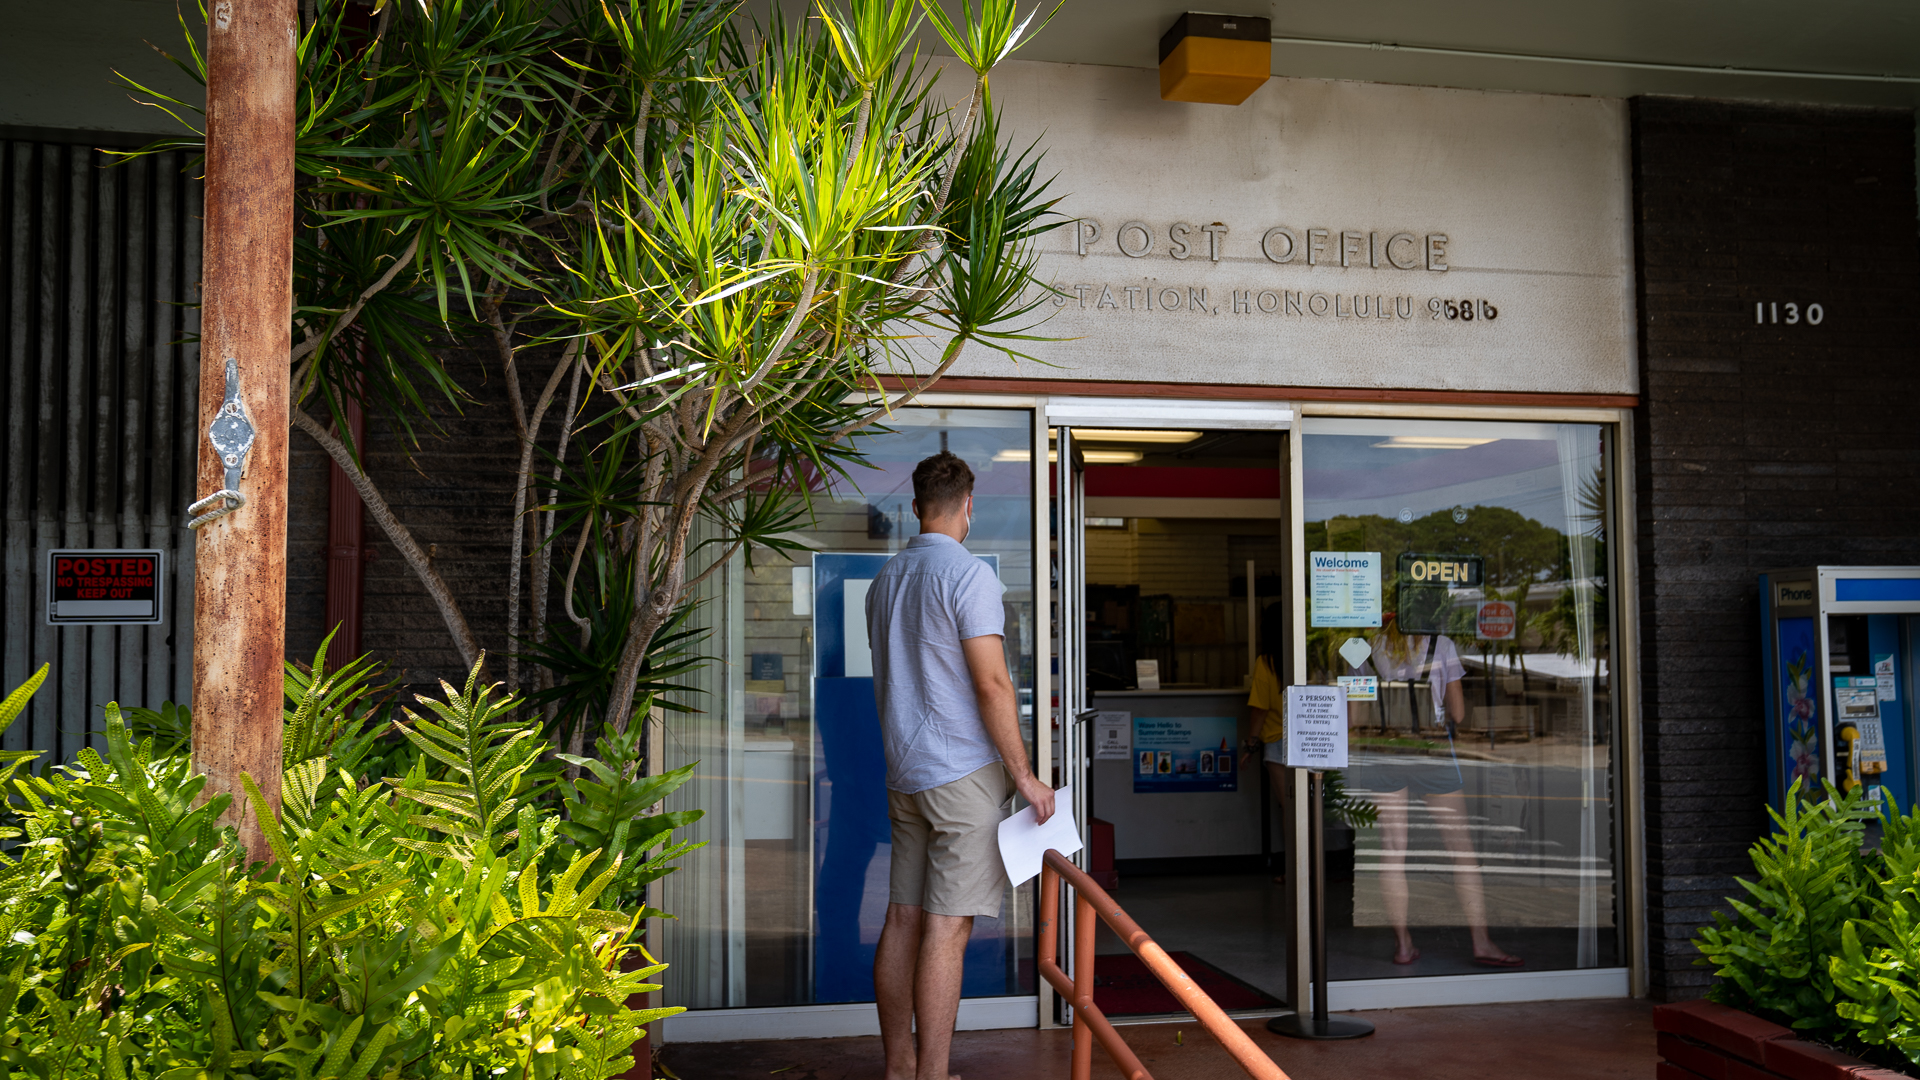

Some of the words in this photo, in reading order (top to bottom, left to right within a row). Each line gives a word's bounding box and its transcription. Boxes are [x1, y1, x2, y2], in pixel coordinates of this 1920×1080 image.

[1077, 218, 1228, 261] POST
[1261, 226, 1448, 271] OFFICE
[1052, 283, 1219, 315] STATION,
[1233, 290, 1413, 319] HONOLULU
[1428, 297, 1498, 321] 96816
[1755, 302, 1824, 326] 1130
[57, 558, 153, 576] POSTED
[1315, 557, 1369, 568] Welcome
[1410, 560, 1469, 582] OPEN
[57, 577, 73, 587] NO
[77, 577, 153, 587] TRESPASSING
[77, 588, 107, 599] KEEP
[110, 588, 133, 599] OUT
[1781, 587, 1812, 601] Phone
